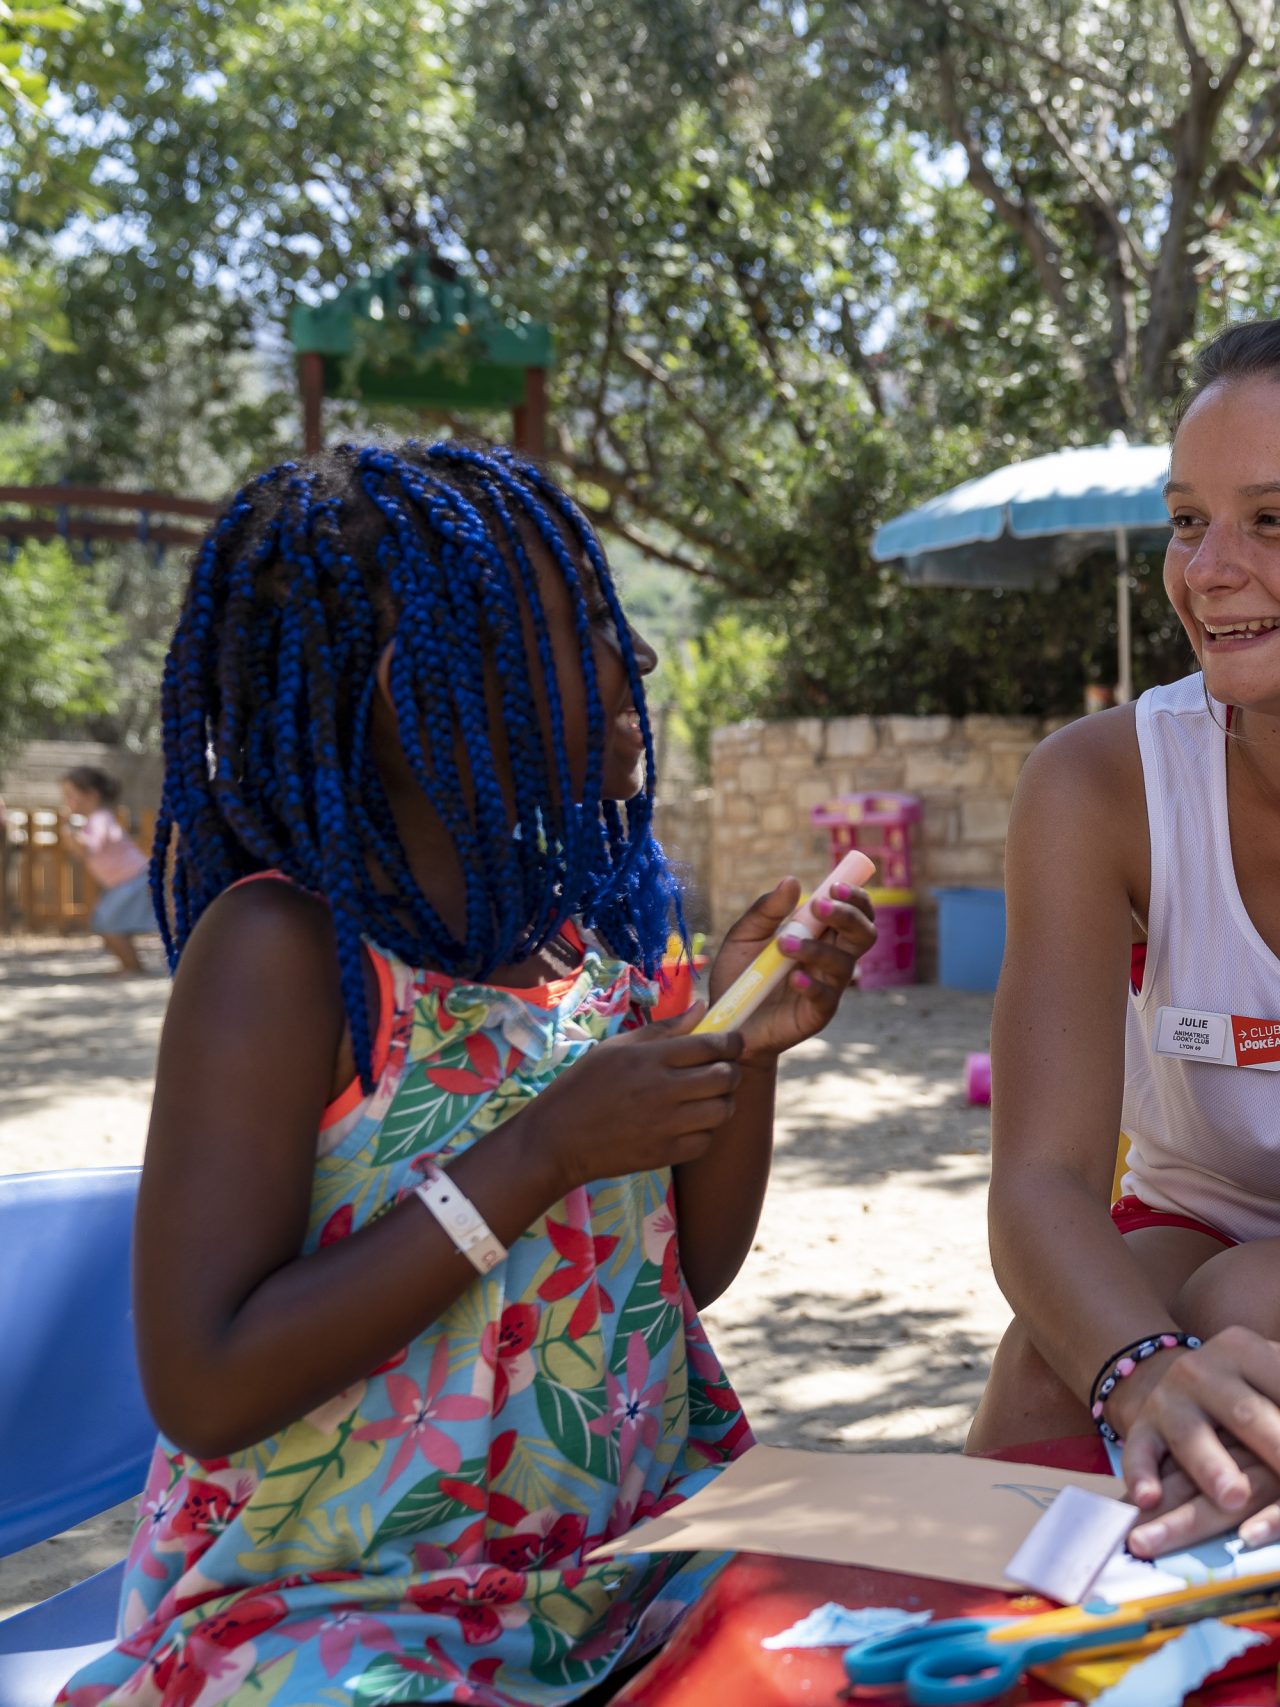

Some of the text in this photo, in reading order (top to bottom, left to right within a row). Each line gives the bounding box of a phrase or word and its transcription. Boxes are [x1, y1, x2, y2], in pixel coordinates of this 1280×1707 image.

[1179, 1017, 1208, 1029] JULIE
[1174, 1030, 1210, 1039] ANIMATRICE
[1250, 1024, 1280, 1037] CLUB
[1194, 1037, 1210, 1045] CLUB
[1179, 1043, 1194, 1051] LYON
